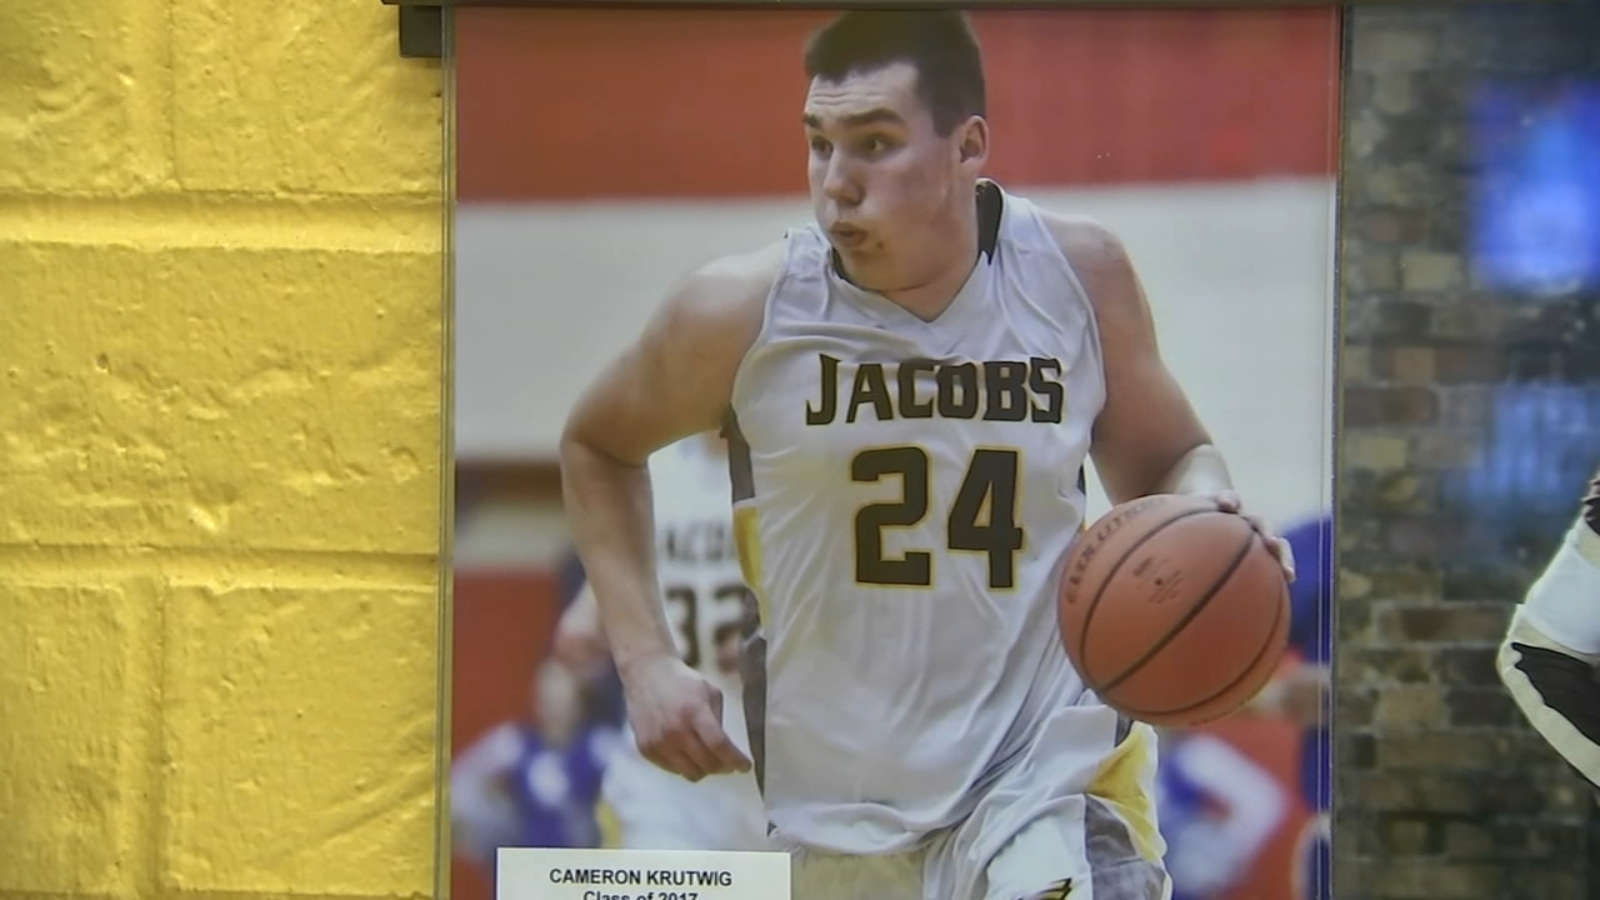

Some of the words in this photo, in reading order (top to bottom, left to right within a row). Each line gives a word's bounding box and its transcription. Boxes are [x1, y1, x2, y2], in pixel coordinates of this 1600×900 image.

[805, 353, 1064, 425] JACOBS
[850, 445, 1024, 589] 24
[549, 868, 641, 885] CAMERON
[646, 870, 732, 886] KRUTWIG
